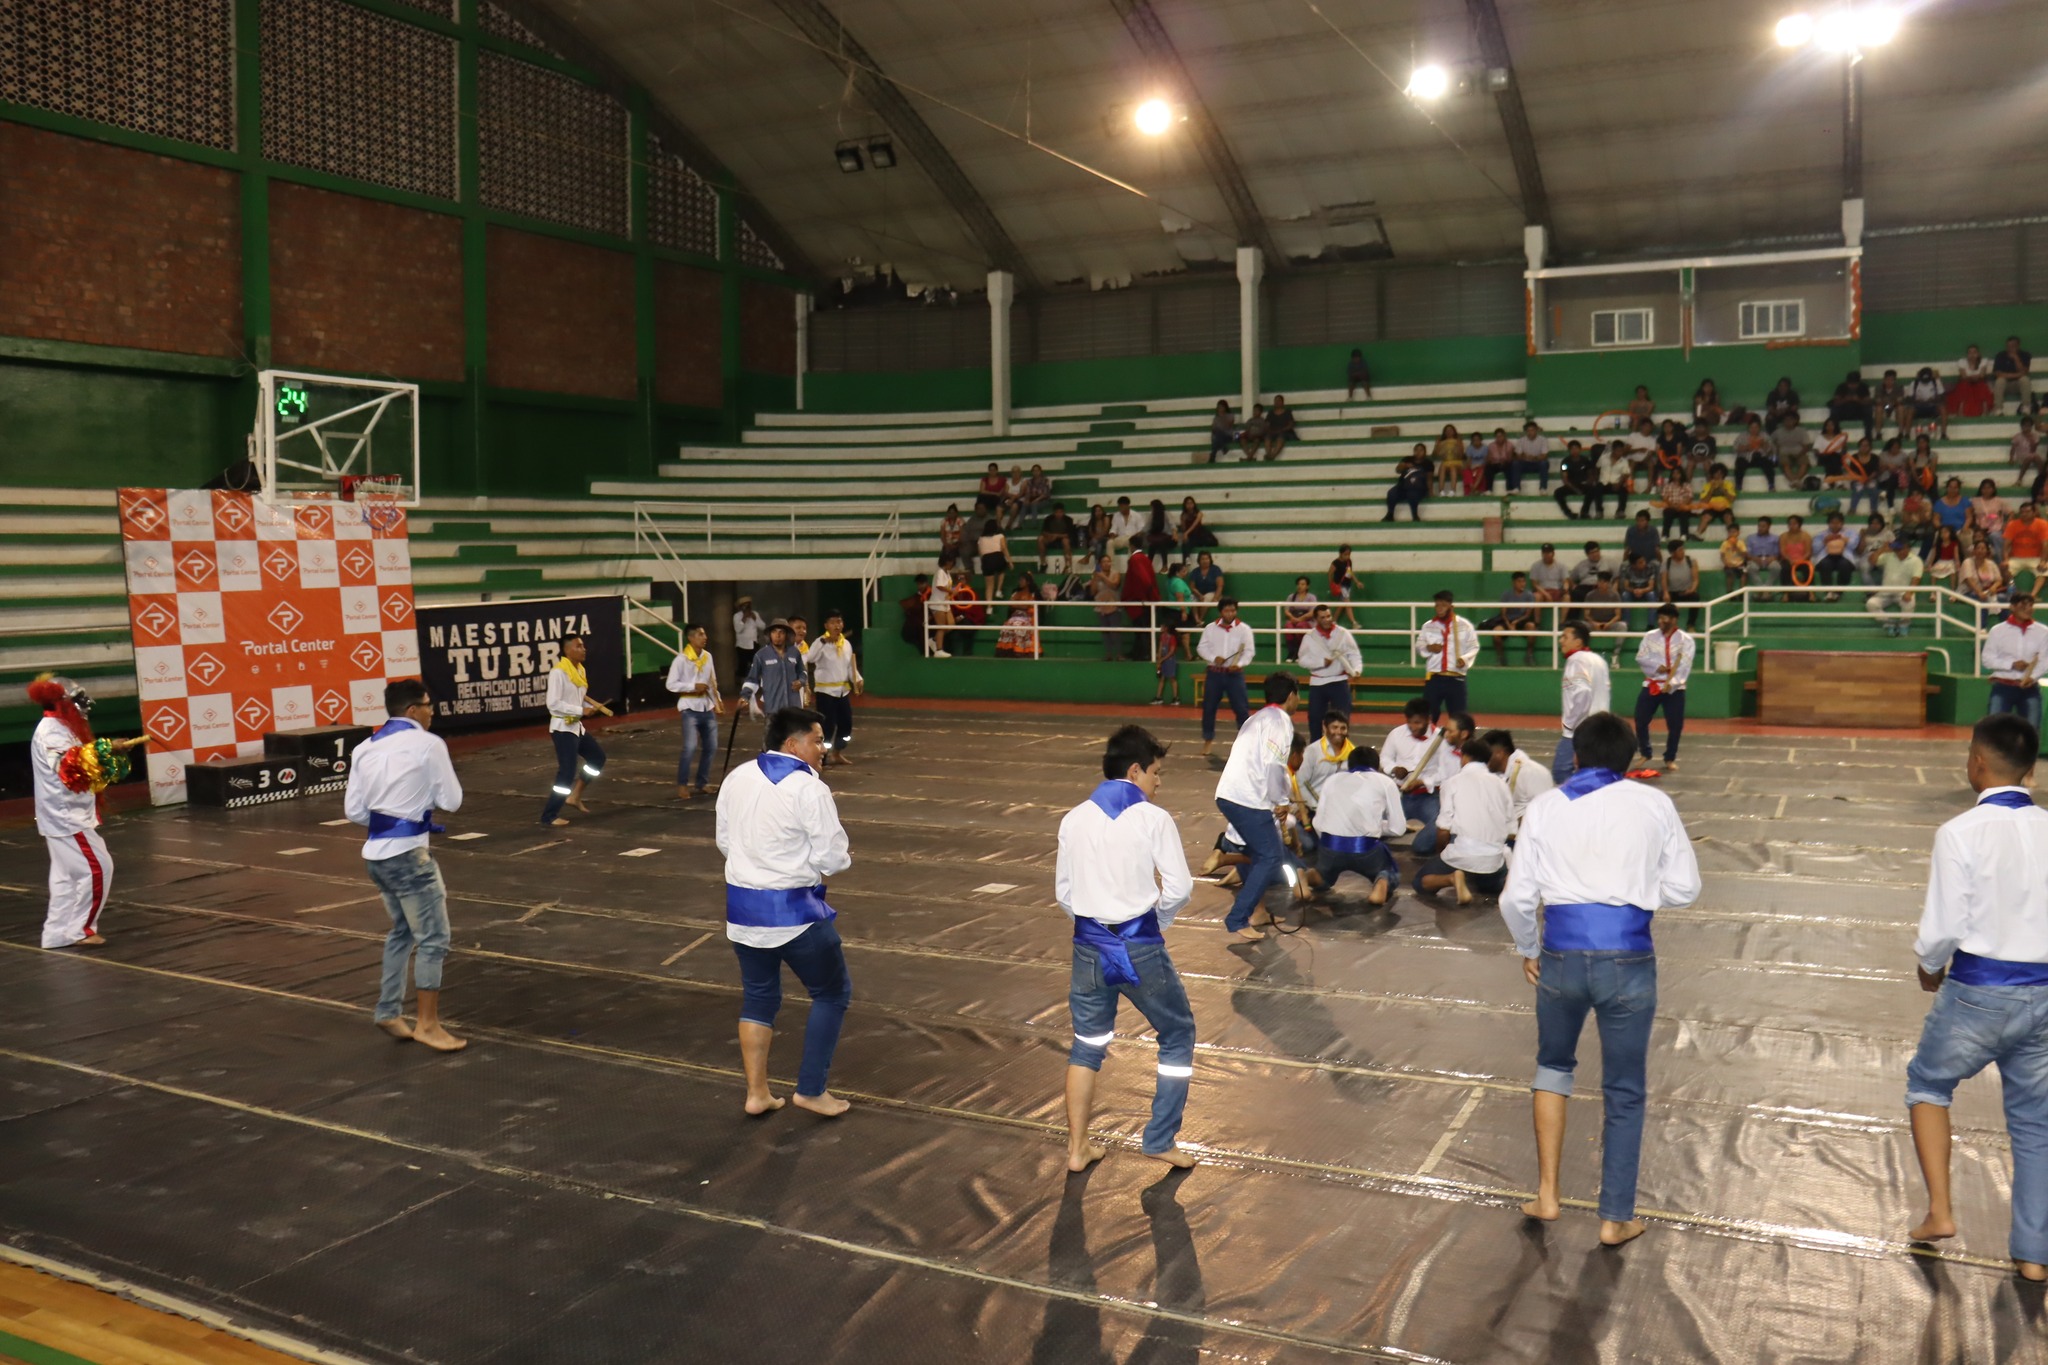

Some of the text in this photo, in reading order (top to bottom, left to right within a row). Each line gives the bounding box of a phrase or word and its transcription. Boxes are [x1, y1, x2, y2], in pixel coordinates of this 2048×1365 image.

[278, 387, 305, 415] 24
[429, 614, 592, 648] MAESTRANZA
[240, 639, 336, 656] Portal Center
[518, 678, 531, 694] DE
[334, 738, 344, 757] 1
[258, 770, 271, 788] 3
